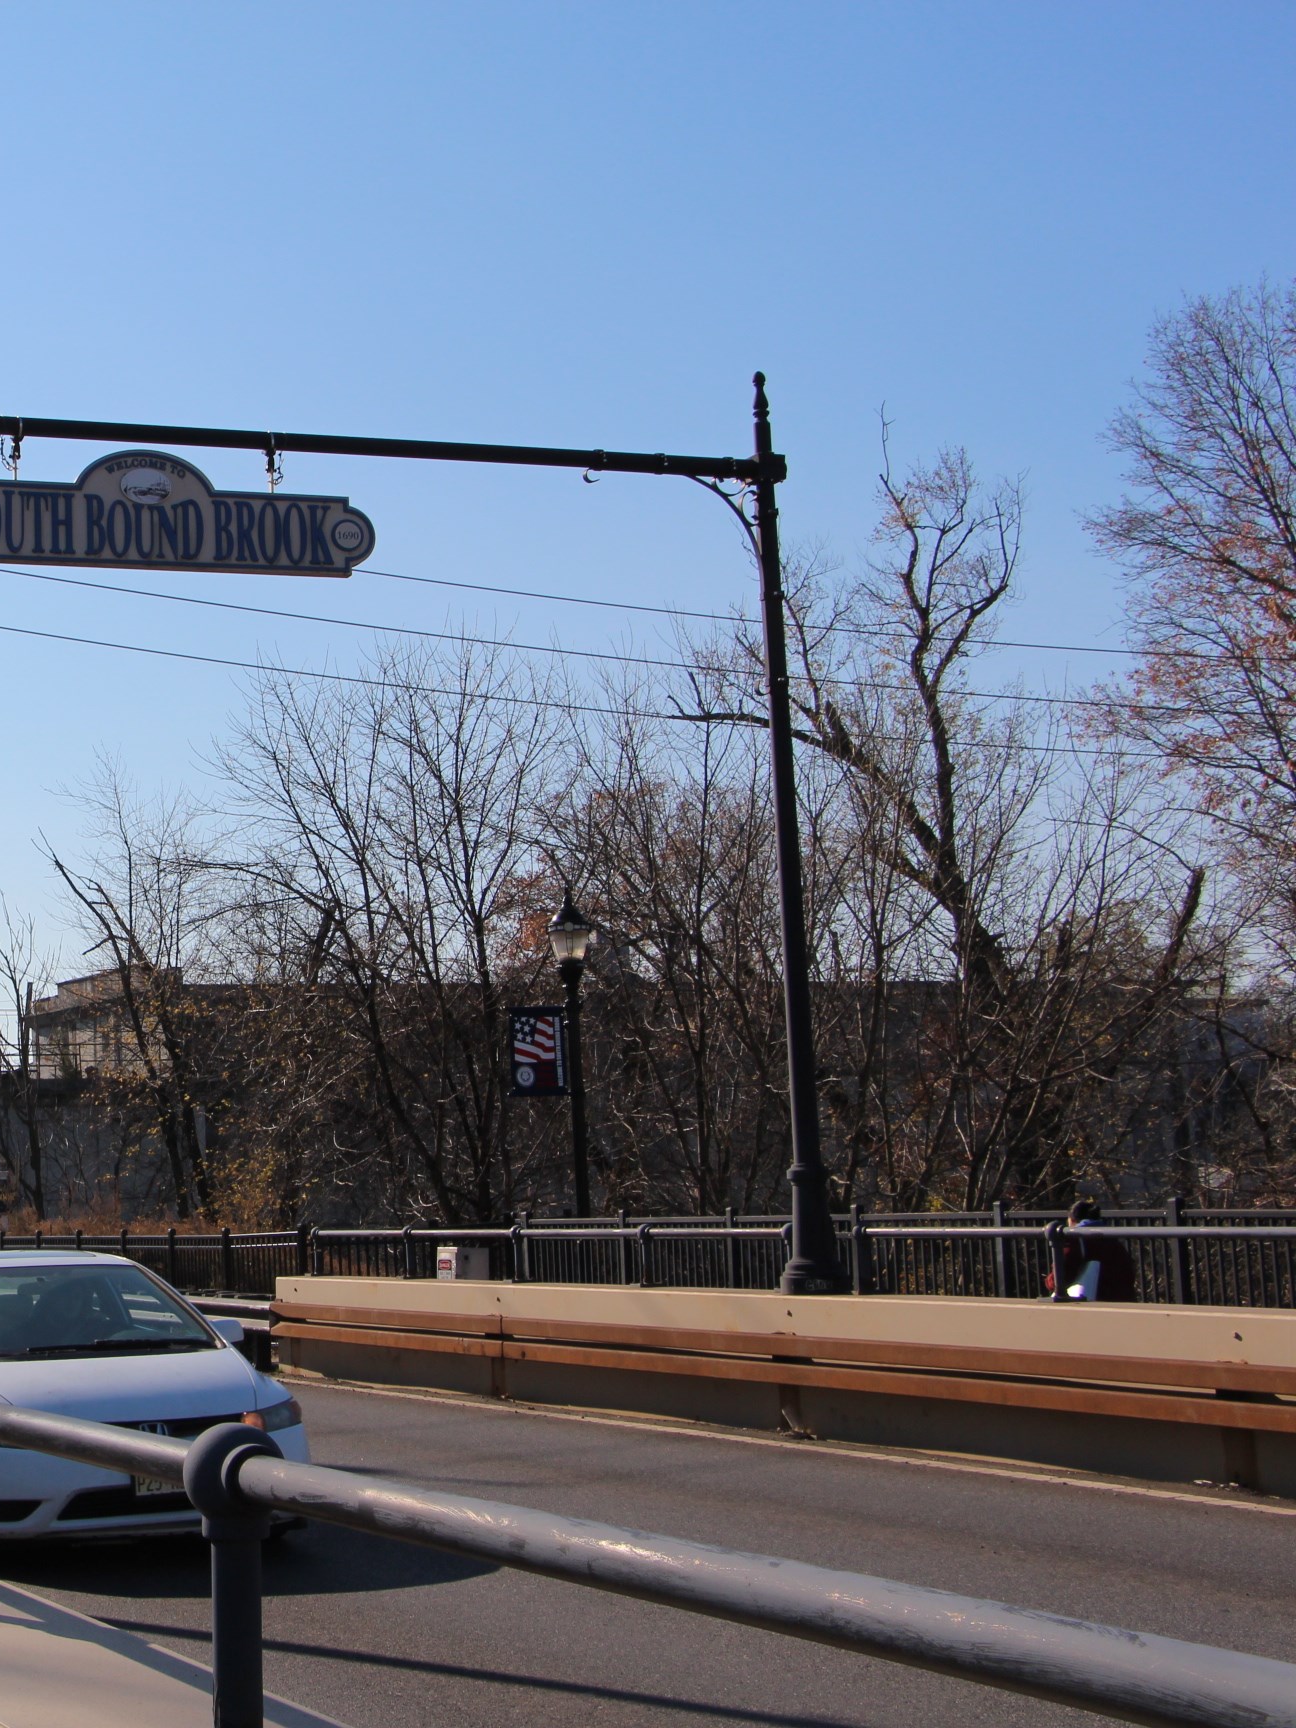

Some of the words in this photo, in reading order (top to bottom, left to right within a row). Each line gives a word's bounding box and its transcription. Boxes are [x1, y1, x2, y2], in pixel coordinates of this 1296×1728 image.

[105, 458, 167, 475] WELCOME
[170, 463, 186, 479] TO
[84, 492, 204, 561] BOUND
[212, 500, 335, 566] BROOK
[337, 530, 360, 541] 1690
